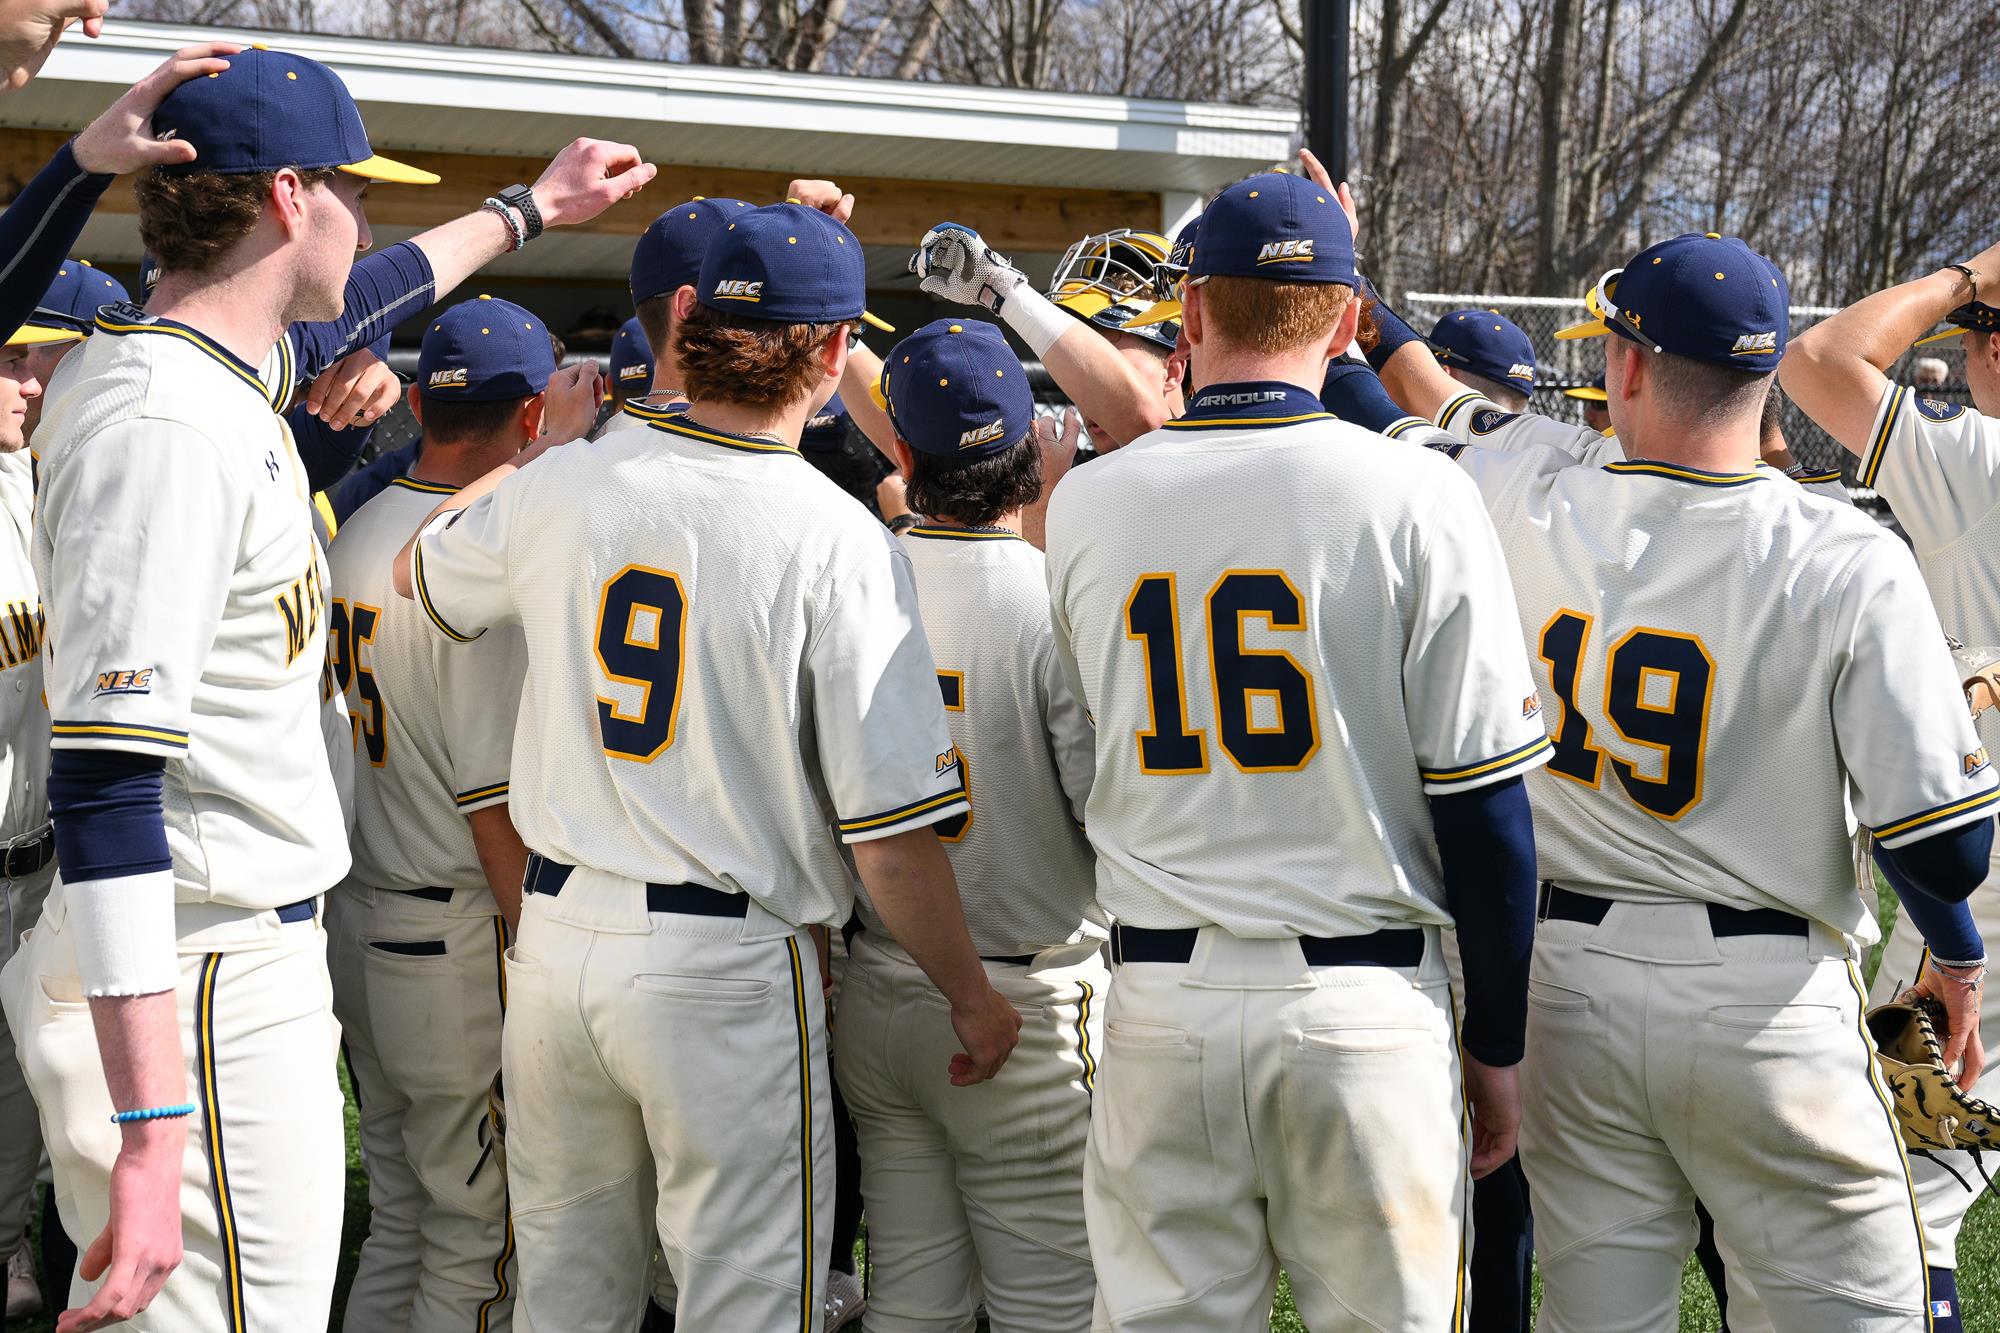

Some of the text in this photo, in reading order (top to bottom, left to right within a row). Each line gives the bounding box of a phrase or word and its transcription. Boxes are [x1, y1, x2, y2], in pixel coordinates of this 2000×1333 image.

[1257, 239, 1314, 260] NEC
[714, 279, 763, 297] NEC
[1732, 331, 1776, 351] NEC
[429, 368, 467, 385] NEC
[620, 363, 647, 379] NEC
[1508, 363, 1533, 378] NEC
[1195, 391, 1287, 408] ARMOUR
[958, 418, 1004, 447] NEC
[593, 563, 688, 764] 9
[1123, 568, 1322, 776] 16
[94, 668, 153, 693] NEC
[1537, 607, 1718, 823] 19
